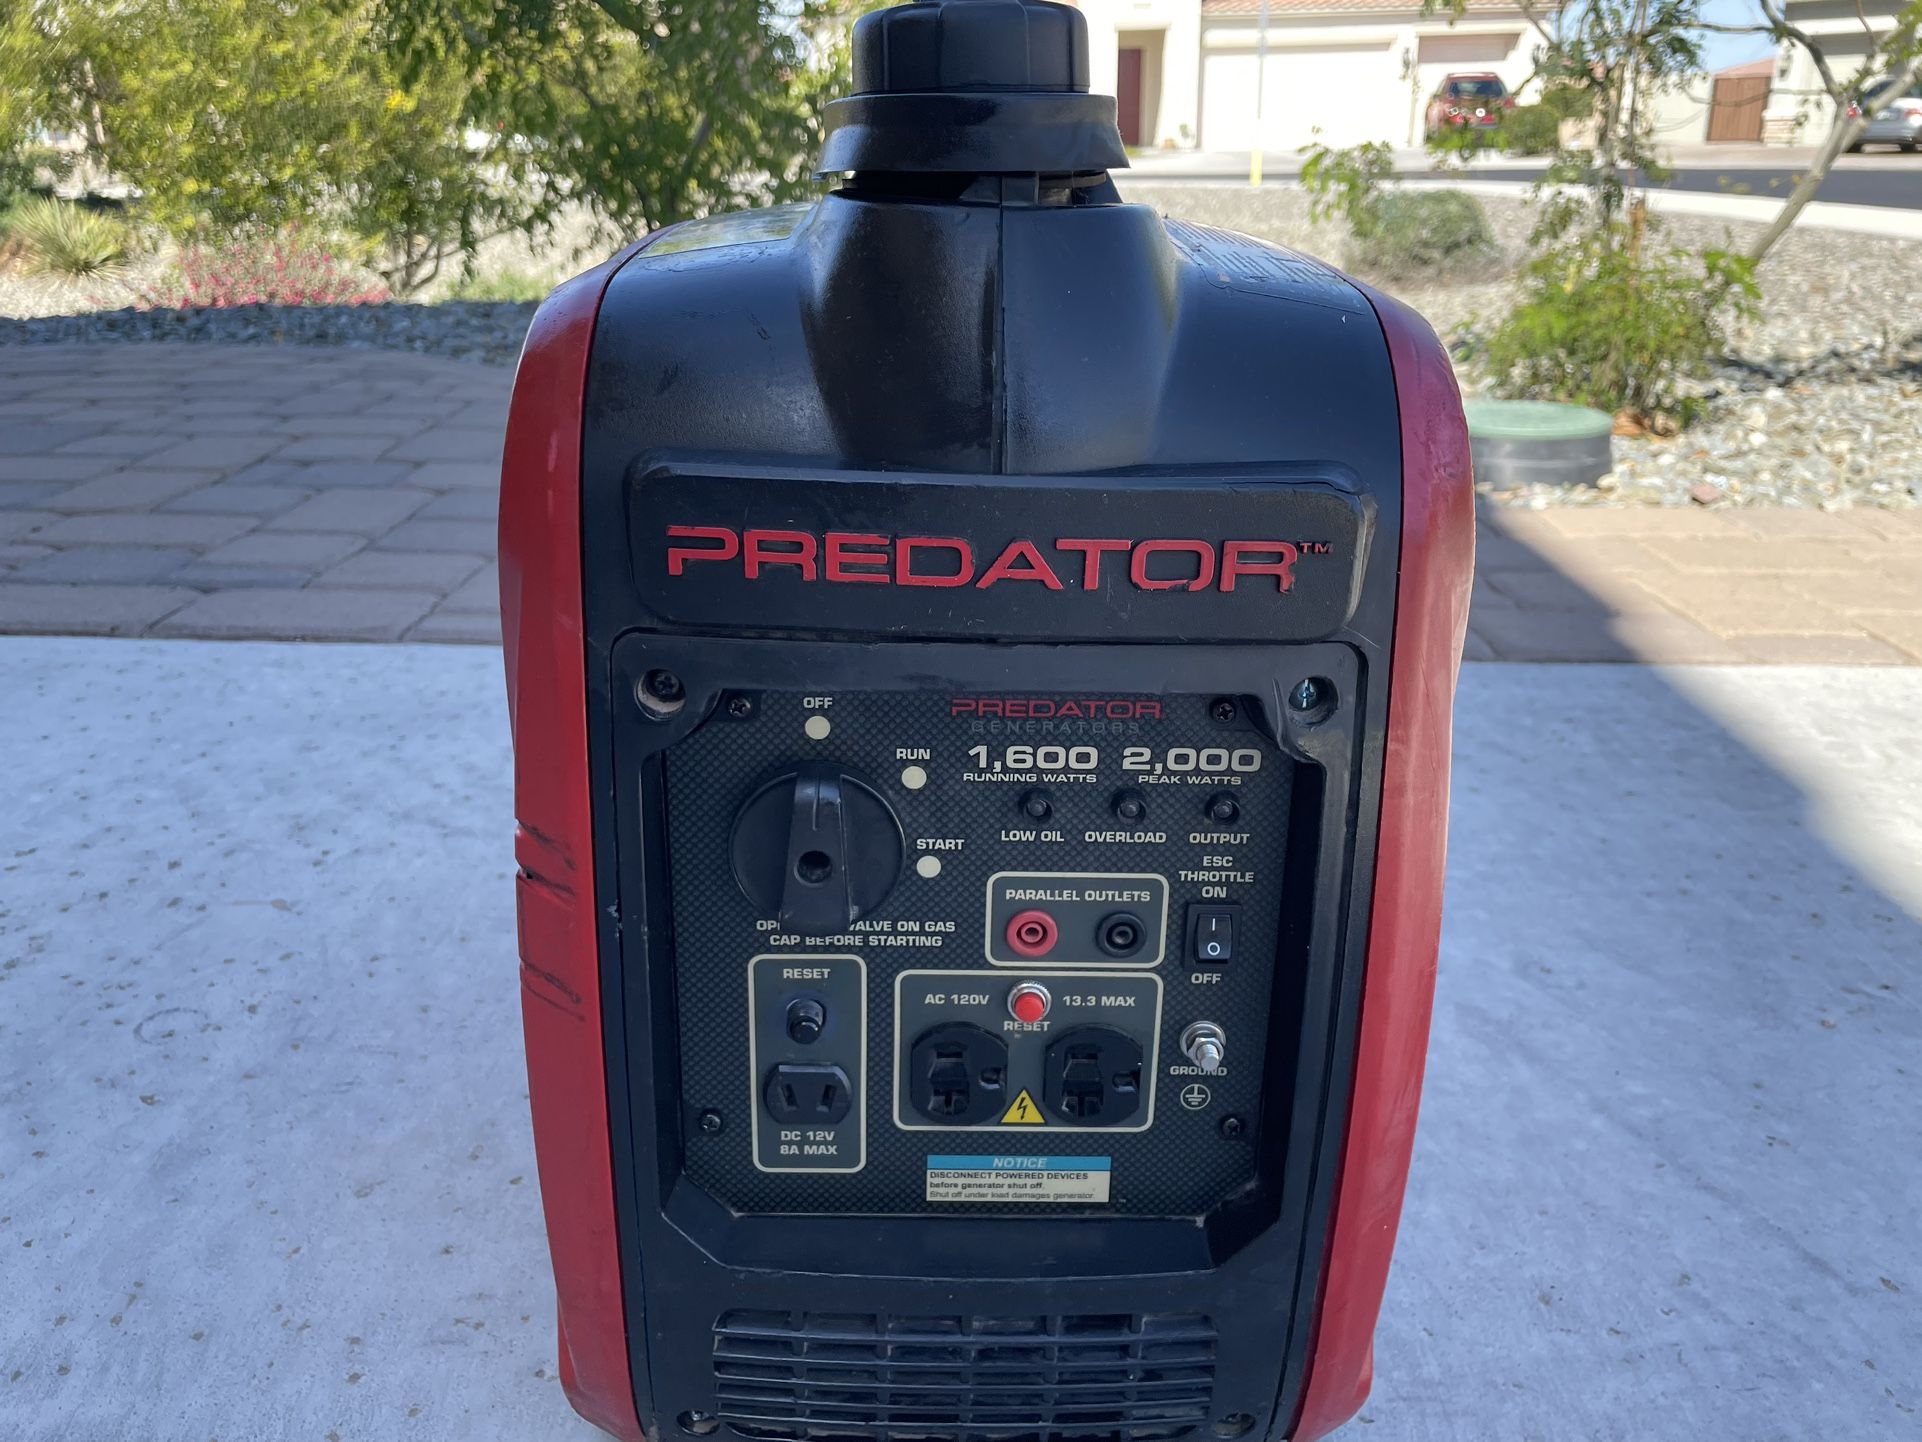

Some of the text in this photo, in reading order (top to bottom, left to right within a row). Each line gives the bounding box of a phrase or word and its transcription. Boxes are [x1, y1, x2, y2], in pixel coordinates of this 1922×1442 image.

[667, 525, 1296, 594] PREDATOR
[803, 697, 833, 709] OFF
[952, 699, 1162, 719] PREDATOR
[971, 720, 1140, 735] GENERATORS
[896, 748, 931, 760] RUN
[968, 745, 1099, 773] 1,600
[1122, 747, 1262, 774] 2,000
[963, 773, 1097, 784] RUNNING WATTS
[1138, 775, 1242, 786] PEAK WATTS
[1001, 830, 1065, 842] LOW OIL
[1084, 831, 1167, 844] OVERLOAD
[1189, 833, 1250, 845] OUTPUT
[916, 838, 965, 850] START
[1202, 856, 1233, 867] ESC
[1178, 870, 1255, 883] THROTTLE
[1005, 889, 1151, 902] PARALLEL OUTLETS
[1201, 886, 1227, 898] ON
[897, 921, 920, 931] ON
[925, 921, 956, 932] GAS
[770, 935, 943, 947] CAP BEFORE STARTING
[783, 968, 831, 979] RESET
[1190, 973, 1222, 985] OFF
[924, 994, 990, 1005] AC 120V
[1063, 996, 1136, 1007] 13.3 MAX
[1003, 1021, 1051, 1032] RESET
[780, 1131, 835, 1142] DC 12V
[780, 1145, 838, 1155] 8A MAX
[992, 1157, 1047, 1168] NOTICE
[930, 1171, 992, 1179] DISCONNECT
[995, 1172, 1044, 1180] POWERED
[930, 1181, 958, 1189] before
[961, 1182, 1005, 1190] generator
[930, 1190, 949, 1199] Shut
[951, 1190, 963, 1199] off
[964, 1190, 989, 1199] under
[991, 1191, 1010, 1199] load
[1012, 1191, 1050, 1201] damages
